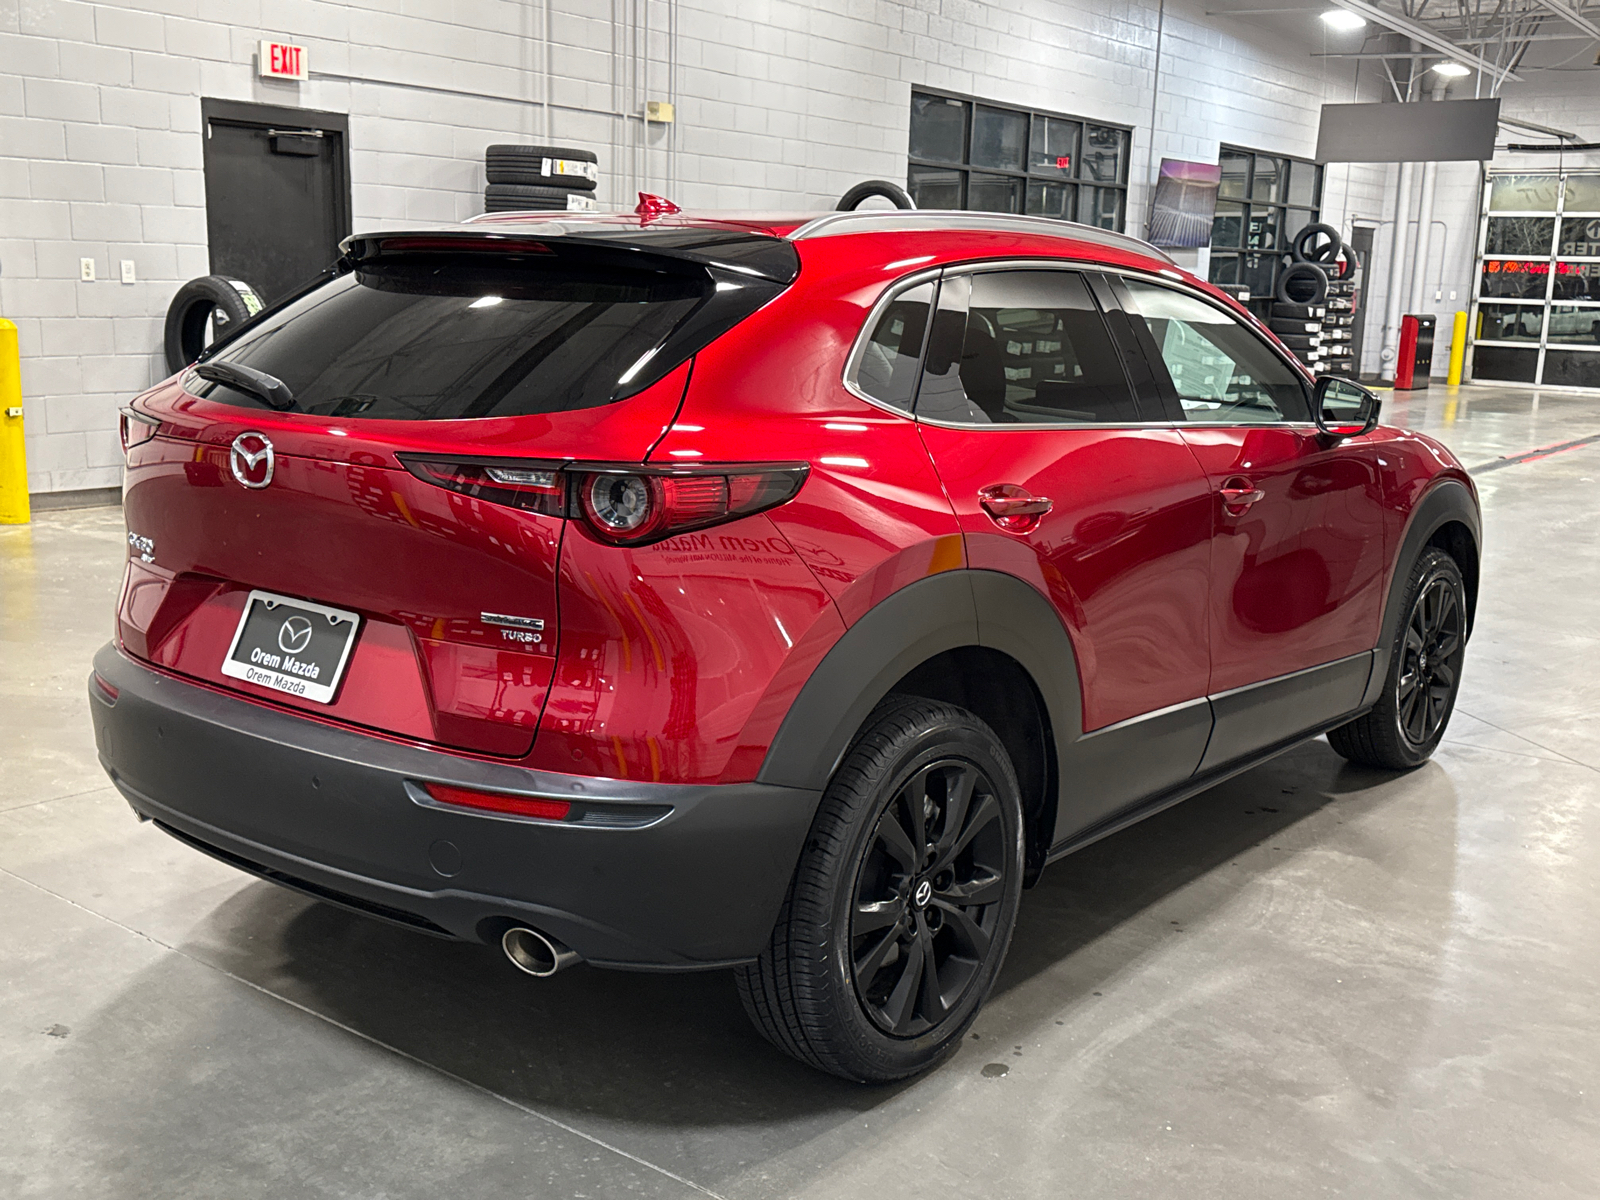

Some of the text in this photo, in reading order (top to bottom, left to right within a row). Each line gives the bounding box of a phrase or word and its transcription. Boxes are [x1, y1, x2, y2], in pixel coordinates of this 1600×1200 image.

[270, 44, 301, 76] EXIT
[500, 629, 542, 643] TURBO
[250, 647, 320, 679] Orem Mazda
[246, 668, 306, 694] Orem Mazda
